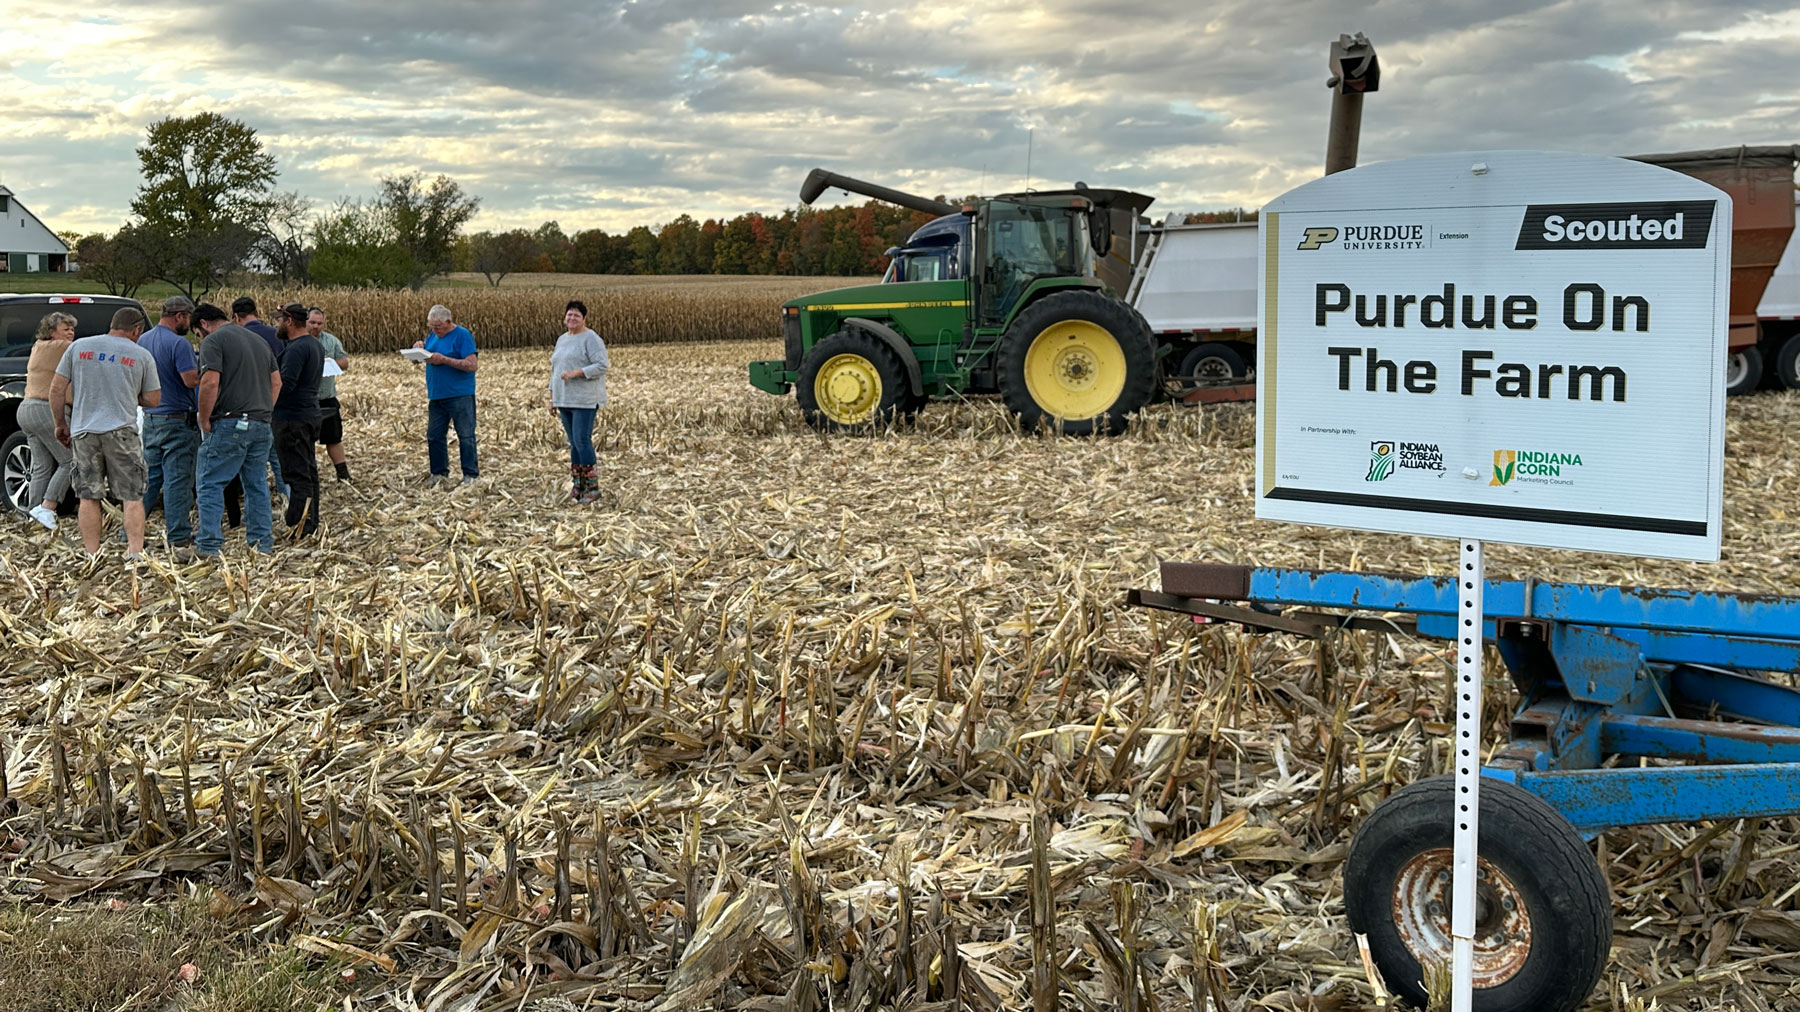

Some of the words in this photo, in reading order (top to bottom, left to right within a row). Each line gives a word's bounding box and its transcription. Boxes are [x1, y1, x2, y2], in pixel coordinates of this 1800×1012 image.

[1343, 225, 1423, 241] PURDUE
[1543, 212, 1684, 242] Scouted
[1439, 232, 1469, 240] Extension
[1343, 241, 1423, 250] UNIVERSITY
[1315, 282, 1539, 331] Purdue
[1562, 282, 1650, 332] On
[79, 351, 94, 360] WE
[98, 353, 106, 361] B
[108, 354, 115, 363] 4
[121, 356, 136, 367] ME
[1327, 346, 1438, 394] The
[1460, 349, 1627, 402] Farm
[1307, 426, 1341, 435] Partnership
[1400, 442, 1440, 453] INDIANA
[1399, 451, 1443, 462] SOYBEAN
[1517, 450, 1583, 466] INDIANA
[1399, 460, 1443, 471] ALLIANCE
[1517, 463, 1560, 476] CORN
[1517, 476, 1548, 485] Marketing
